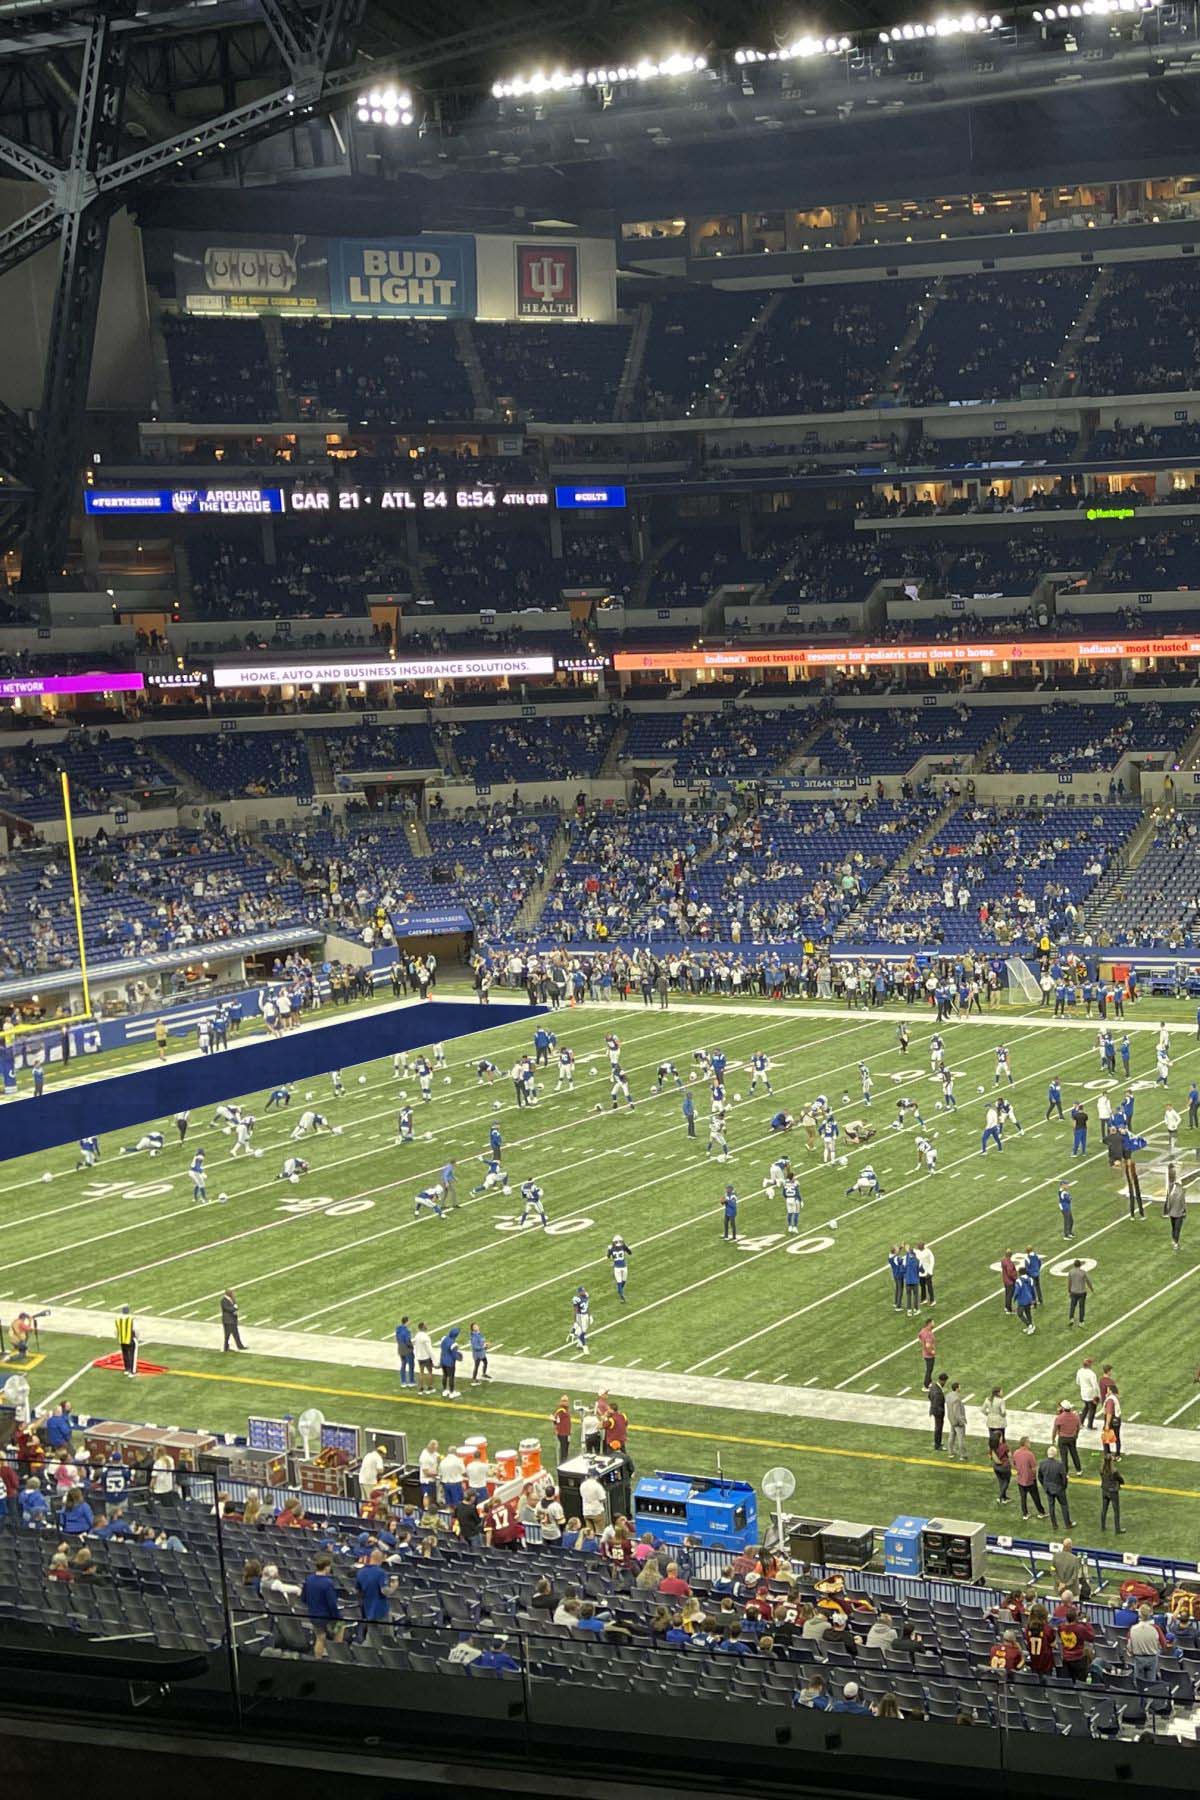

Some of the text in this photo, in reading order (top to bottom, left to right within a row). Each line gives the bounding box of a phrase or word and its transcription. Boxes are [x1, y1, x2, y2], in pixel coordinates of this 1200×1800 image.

[363, 249, 440, 277] BUD
[350, 276, 456, 305] LIGHT
[522, 303, 574, 313] HEALTH
[206, 490, 261, 502] AROUND
[291, 491, 548, 509] CAR 21 ATL 24 6:54 4TH QTR
[200, 500, 271, 513] THE LEAGUE
[1097, 508, 1135, 520] Huntington
[1079, 644, 1123, 655] Indiana's
[1126, 644, 1150, 653] most
[1152, 641, 1187, 651] trusted
[558, 658, 611, 668] SELECTIVE
[148, 673, 209, 685] SELECTIVE
[240, 662, 529, 682] HOME, AUTO AND BUSINESS INSURANCE SOLUTIONS.
[3, 681, 45, 693] NETWORK
[106, 1477, 125, 1493] 53
[491, 1507, 510, 1530] 17
[1030, 1636, 1043, 1656] 17
